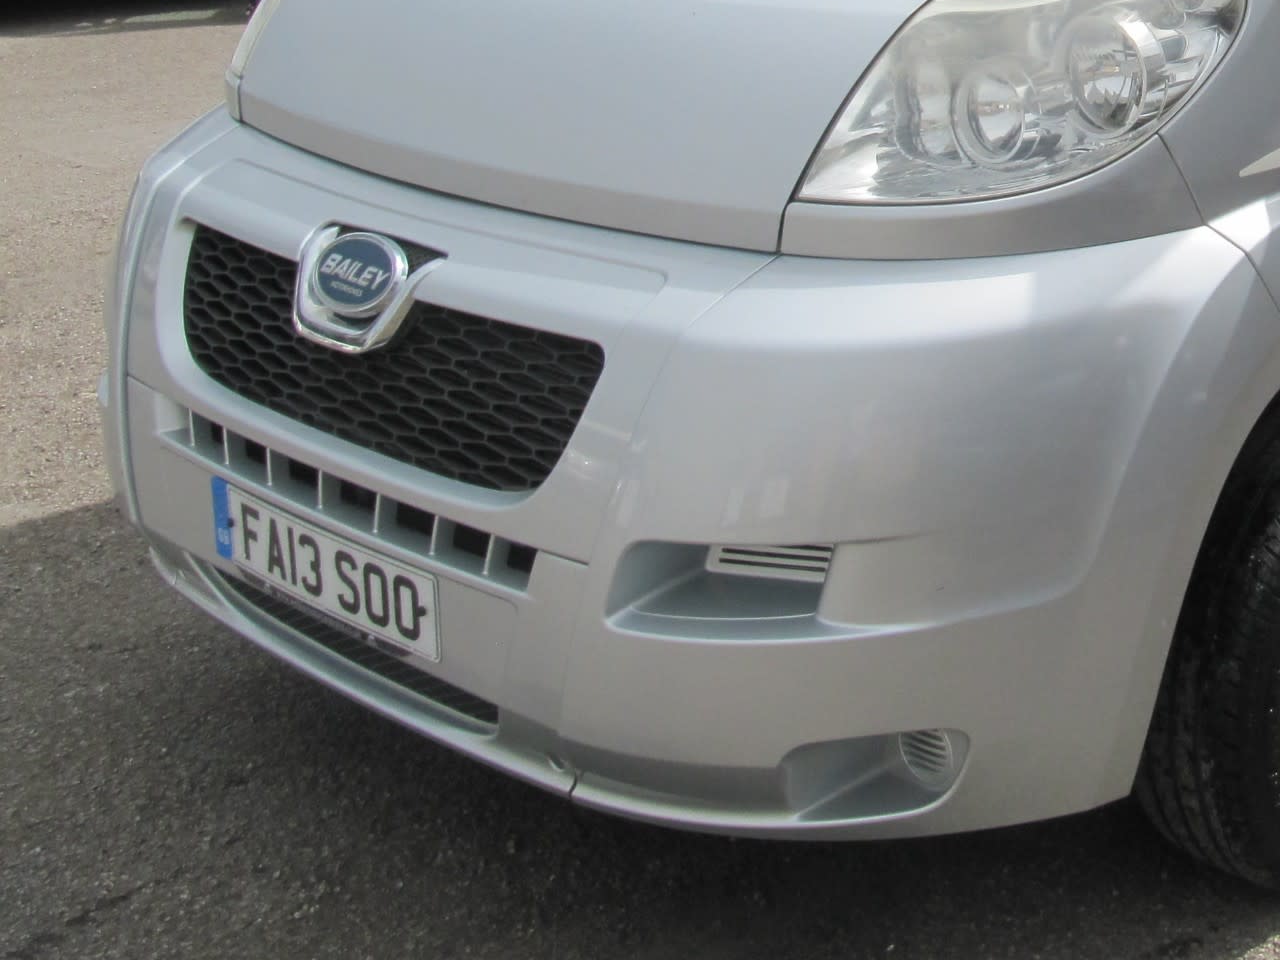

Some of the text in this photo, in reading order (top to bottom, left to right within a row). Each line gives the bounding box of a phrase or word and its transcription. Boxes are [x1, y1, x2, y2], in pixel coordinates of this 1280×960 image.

[320, 253, 390, 290] BAILEY
[241, 503, 323, 597] FA13
[335, 550, 421, 641] SOO
